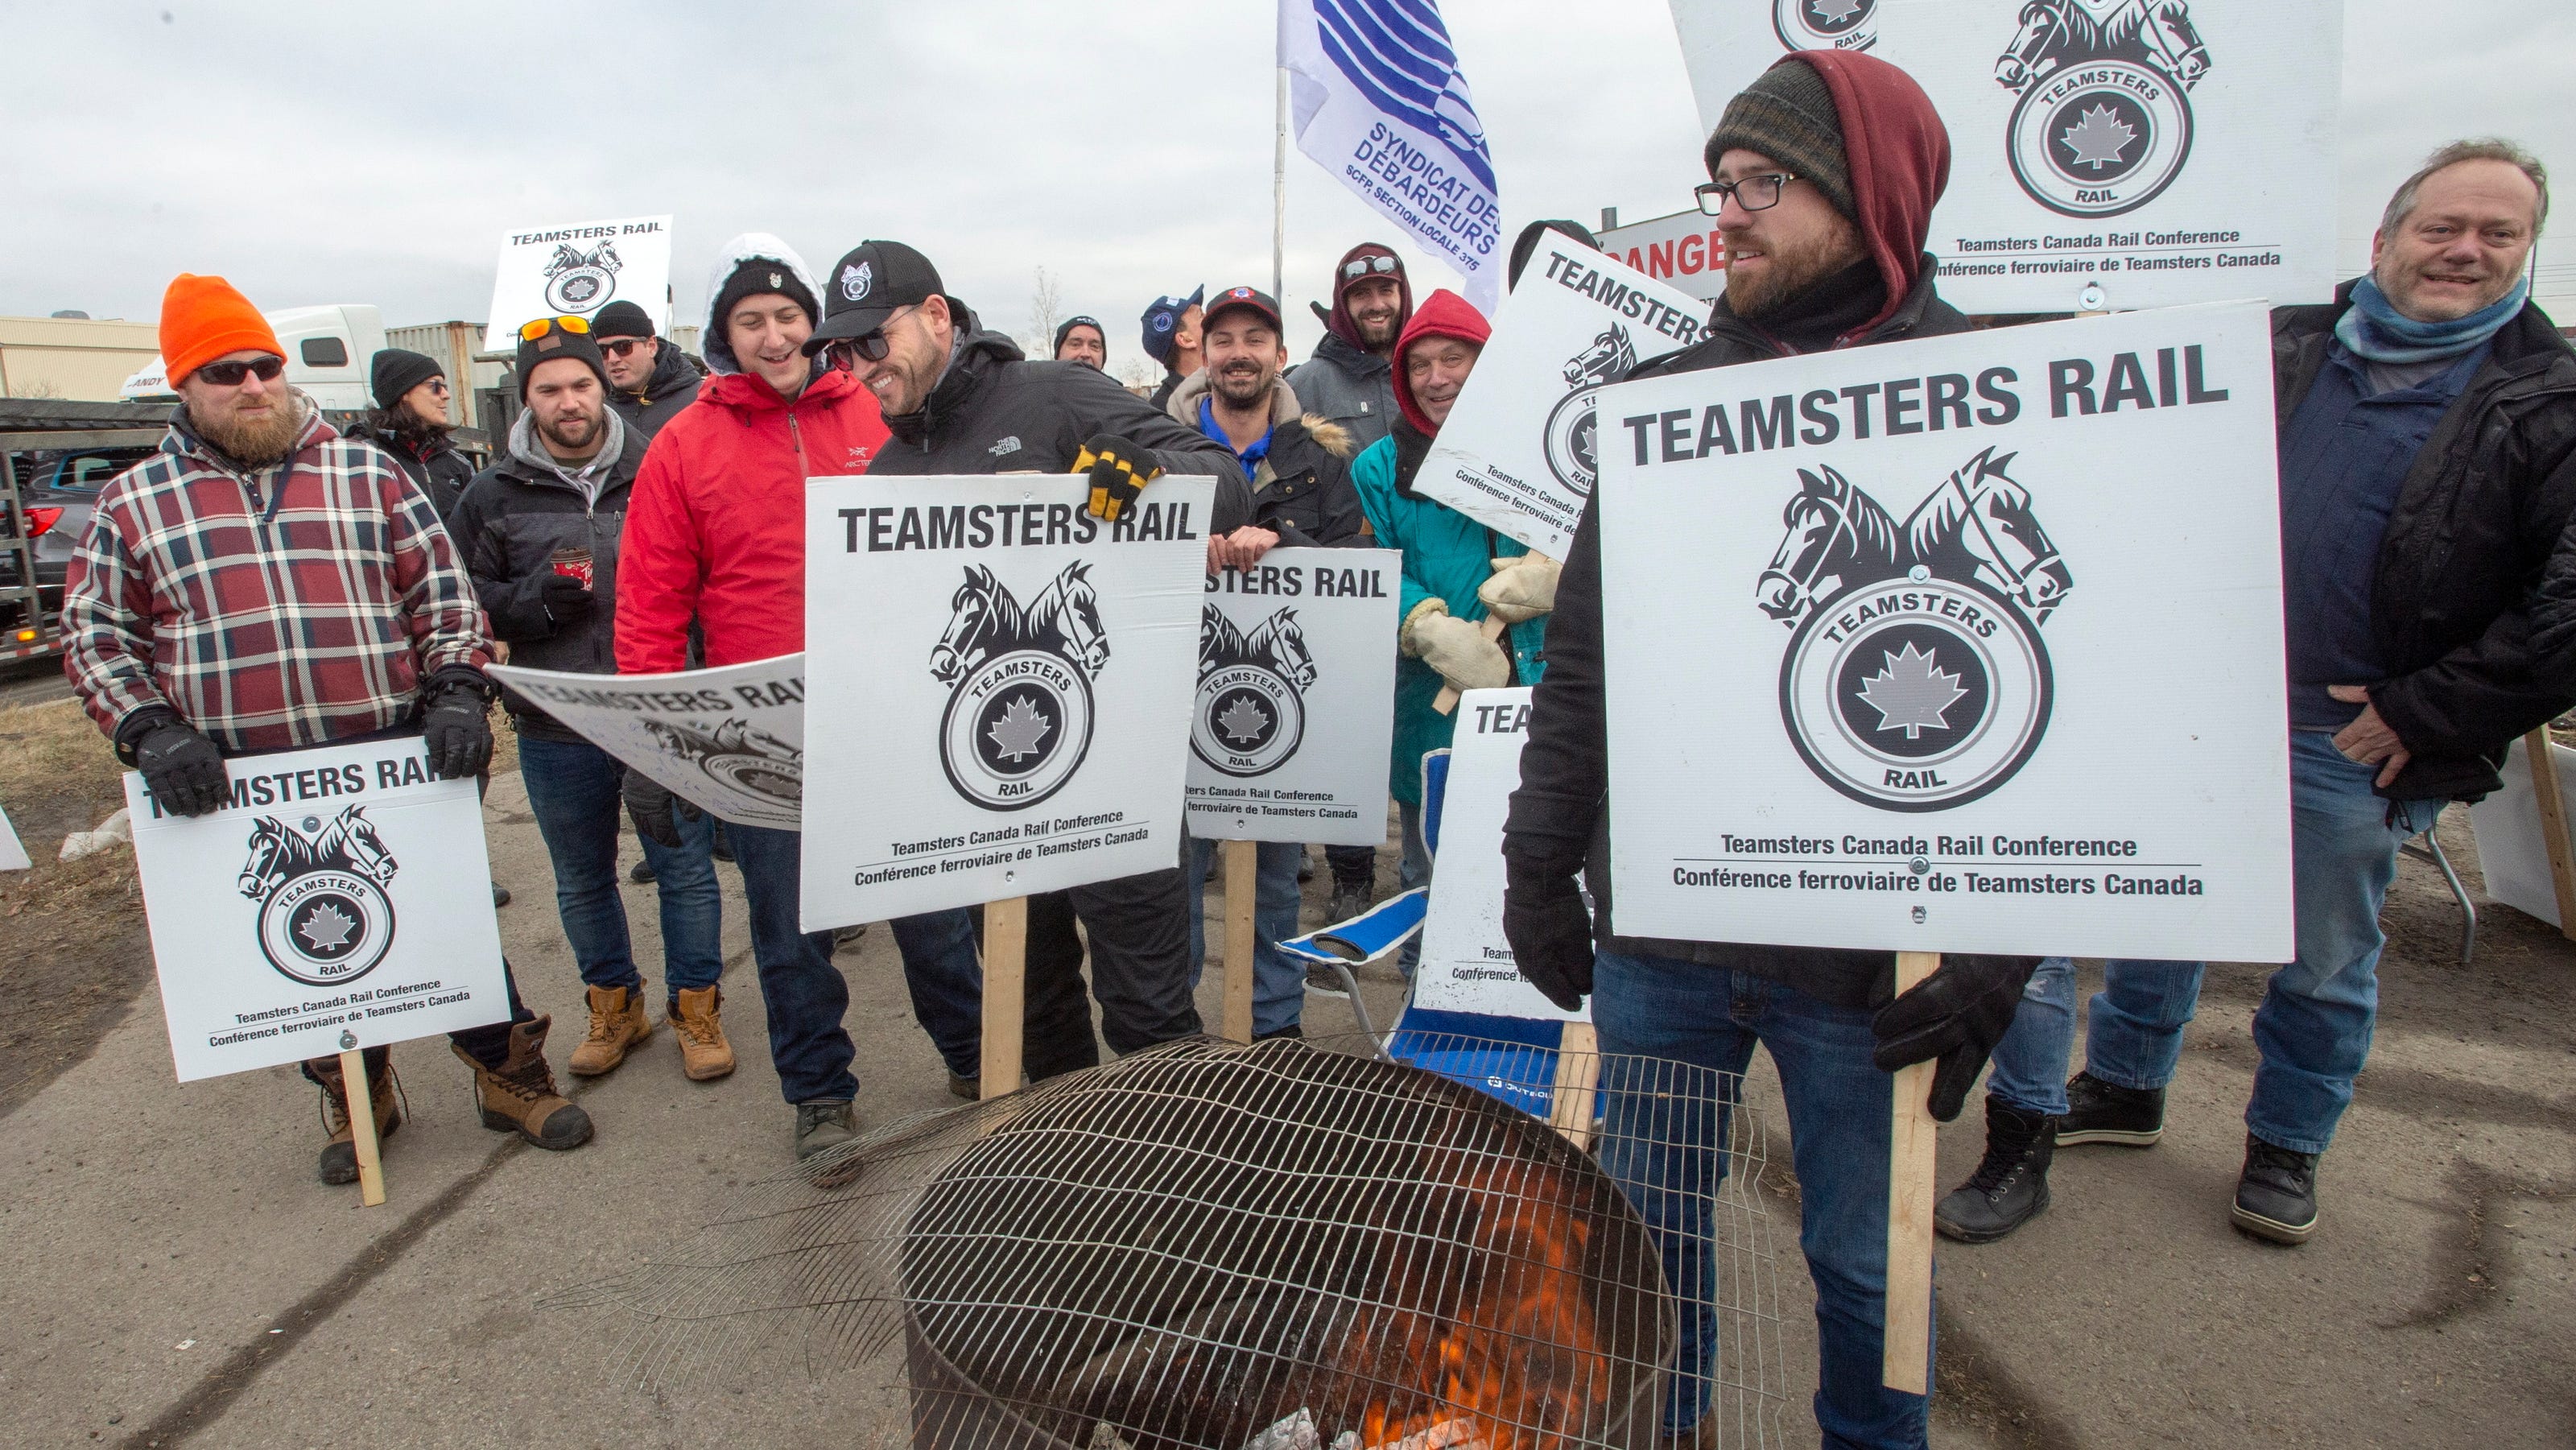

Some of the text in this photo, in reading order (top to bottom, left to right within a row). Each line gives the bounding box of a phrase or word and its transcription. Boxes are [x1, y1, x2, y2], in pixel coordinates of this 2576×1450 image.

[1835, 32, 1865, 48] RAIL
[2041, 71, 2159, 107] TEAMSTERS
[1369, 122, 1469, 203] SYNDICAT
[1354, 139, 1496, 255] DÉBARDEURS
[2074, 188, 2117, 204] RAIL
[1346, 164, 1480, 271] SCFP, SECTION LOCALE 375
[512, 222, 663, 246] TEAMSTERS RAIL
[1956, 228, 2240, 251] Teamsters Canada Rail Conference
[560, 269, 605, 281] TEAMSTERS
[2011, 256, 2095, 275] ferroviaire
[2100, 258, 2120, 271] de
[2124, 256, 2210, 273] Teamsters
[2217, 251, 2281, 268] Canada
[128, 377, 166, 387] ANDY
[1624, 345, 2229, 467] TEAMSTERS RAIL
[1455, 469, 1511, 505] Conférence
[1510, 497, 1562, 531] ferroviaire
[1487, 464, 1575, 515] Teamsters Canada
[839, 502, 1197, 553] TEAMSTERS RAIL
[1315, 568, 1387, 598] RAIL
[1823, 592, 1996, 647] TEAMSTERS
[972, 660, 1071, 699] TEAMSTERS
[1204, 671, 1284, 698] TEAMSTERS
[1228, 756, 1257, 766] RAIL
[998, 781, 1034, 796] RAIL
[1209, 787, 1246, 797] Canada
[1250, 788, 1270, 799] Rail
[1274, 790, 1333, 801] Conference
[1883, 768, 1947, 790] RAIL
[1188, 802, 1358, 819] ferroviaire de Teamsters Canada
[891, 810, 1123, 857] Teamsters Canada Rail Conference
[1721, 834, 2137, 858] Teamsters Canada Rail Conference
[854, 827, 1148, 886] Conférence ferroviaire de Teamsters Canada
[279, 878, 366, 910] TEAMSTERS
[1673, 866, 2203, 896] Conférence ferroviaire de Teamsters Canada
[320, 963, 351, 976] RAIL
[1452, 968, 1517, 981] Conférence
[236, 978, 441, 1024] Teamsters Canada Rail Conference
[209, 990, 471, 1047] Conférence ferroviaire de Teamsters Canada
